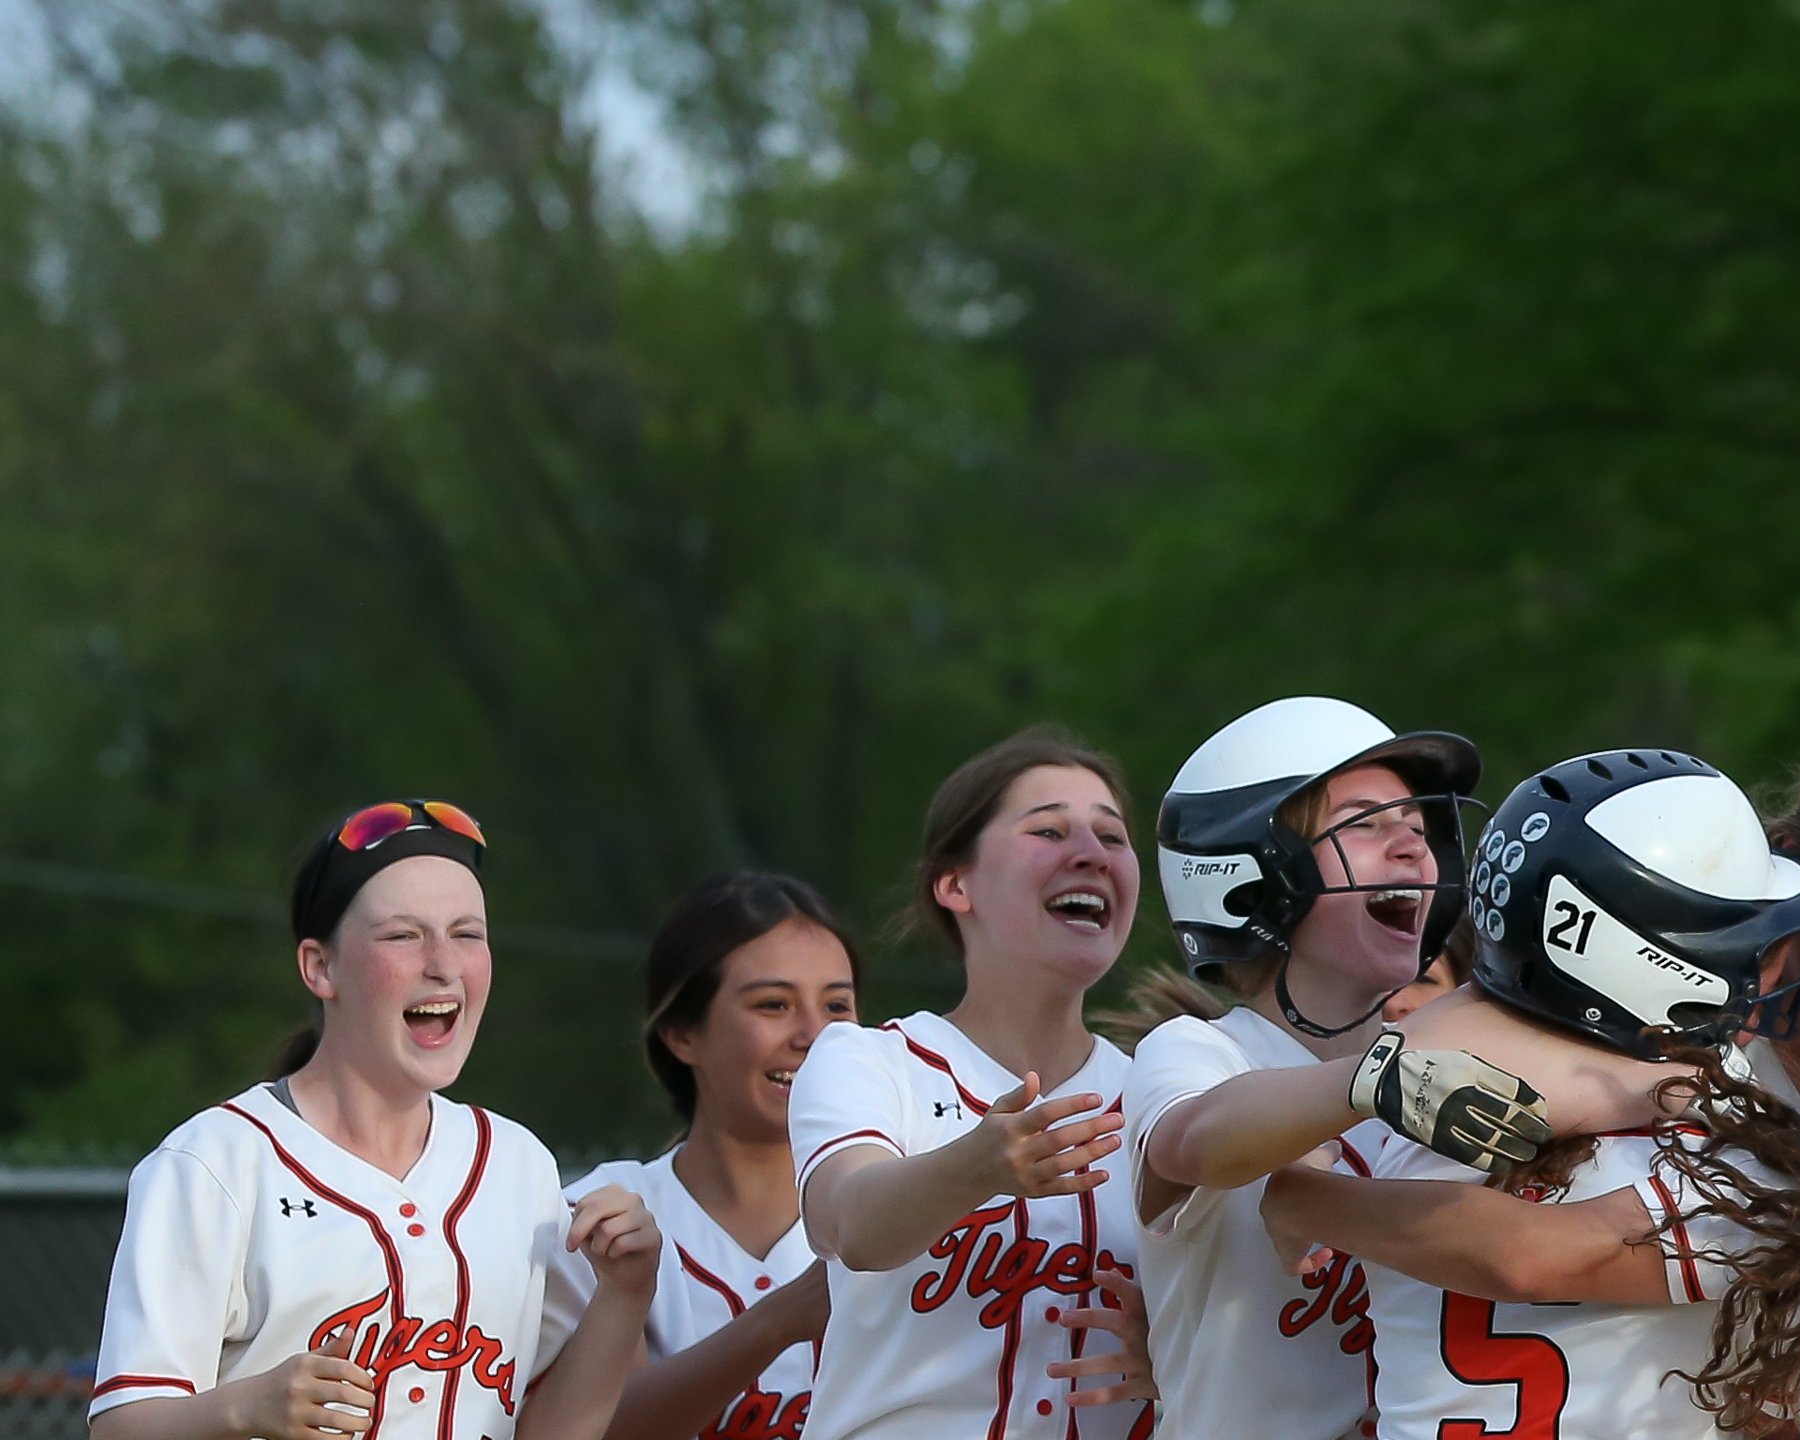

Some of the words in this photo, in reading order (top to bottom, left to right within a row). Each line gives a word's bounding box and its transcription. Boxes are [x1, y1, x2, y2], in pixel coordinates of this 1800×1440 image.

[1194, 863, 1241, 876] RIP-IT
[1547, 900, 1597, 955] 21
[1636, 947, 1714, 987] RIP-IT
[911, 1200, 1134, 1329] Tiger
